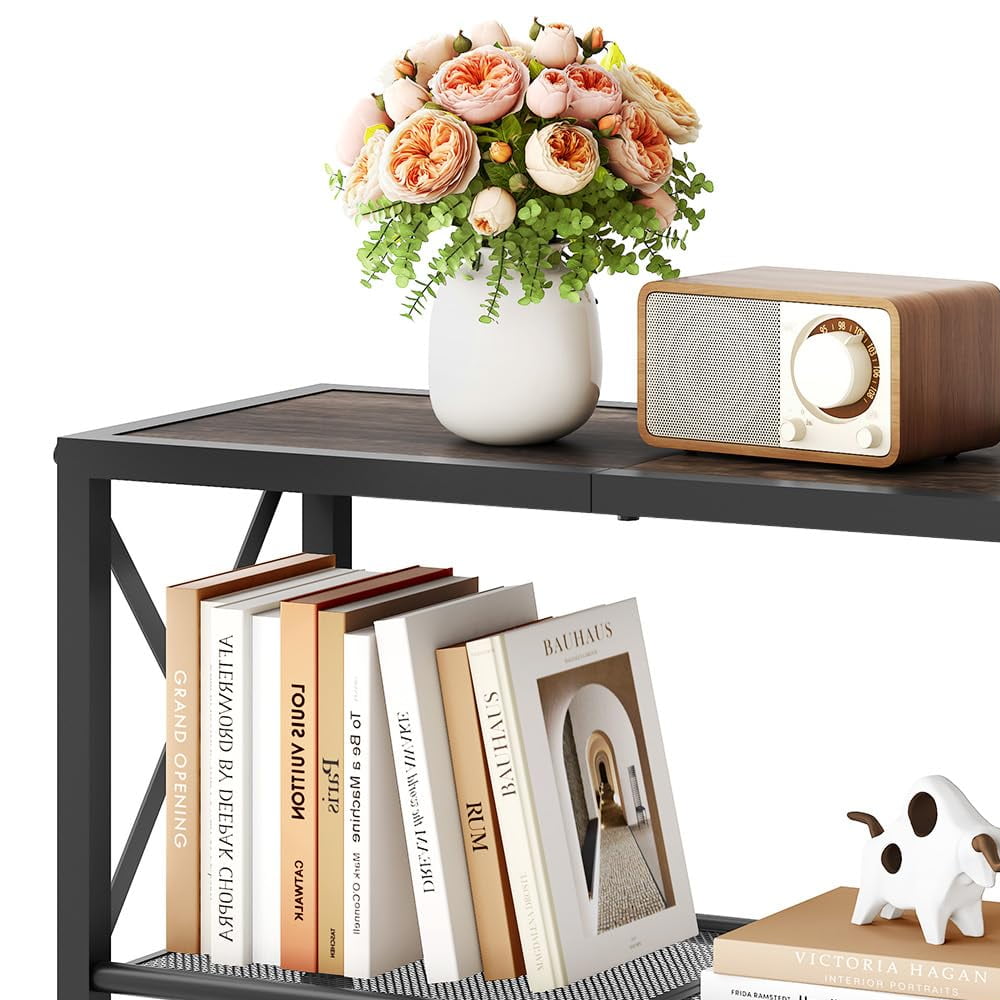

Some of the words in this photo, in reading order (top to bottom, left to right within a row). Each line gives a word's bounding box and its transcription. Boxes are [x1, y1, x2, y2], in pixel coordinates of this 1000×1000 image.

[838, 321, 846, 330] 98
[867, 343, 877, 357] 103
[866, 386, 877, 399] 108
[543, 622, 614, 656] BAUHAUS
[173, 670, 188, 743] GRAND
[484, 691, 516, 797] BAUHAUS
[173, 754, 188, 849] OPENING
[466, 801, 488, 852] RUM
[794, 951, 899, 975] VICTORIA
[910, 964, 988, 984] HAGAN
[731, 989, 752, 1000] FRIDA
[824, 975, 885, 989] INTERIOR
[890, 981, 960, 997] PORTRAITS
